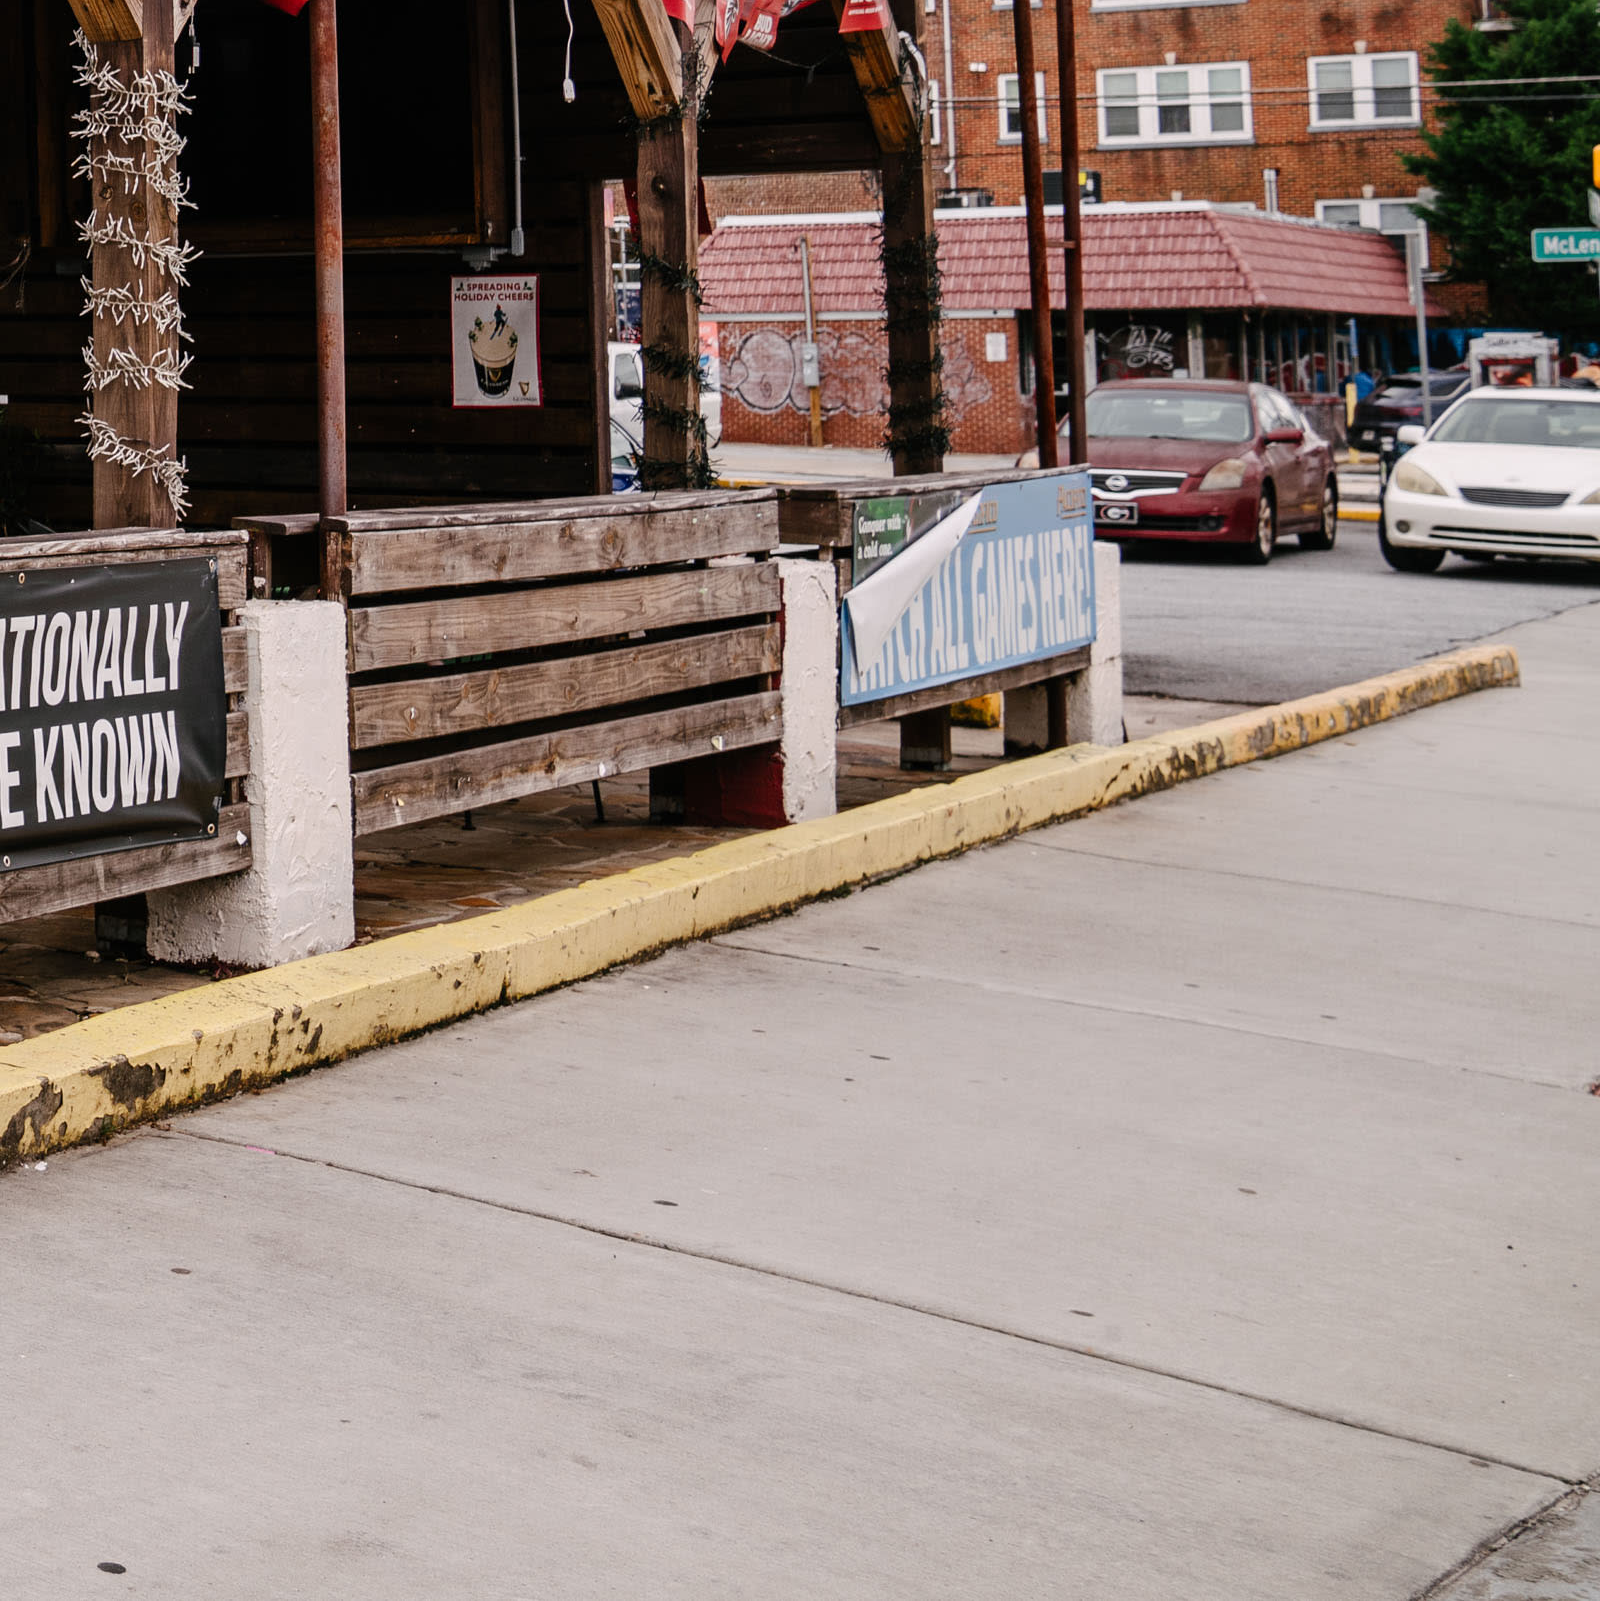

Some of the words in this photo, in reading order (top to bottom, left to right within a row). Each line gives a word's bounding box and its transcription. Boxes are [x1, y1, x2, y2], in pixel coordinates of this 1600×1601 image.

[753, 13, 773, 33] BUD
[454, 293, 496, 302] HOLIDAY
[497, 292, 535, 301] CHEERS
[466, 282, 521, 292] SPREADING
[858, 516, 886, 537] Conquer
[863, 540, 878, 559] cold
[930, 546, 969, 677] ALL
[971, 534, 1038, 665] GAMES
[1038, 525, 1093, 649] HERE!
[32, 709, 182, 824] KNOWN
